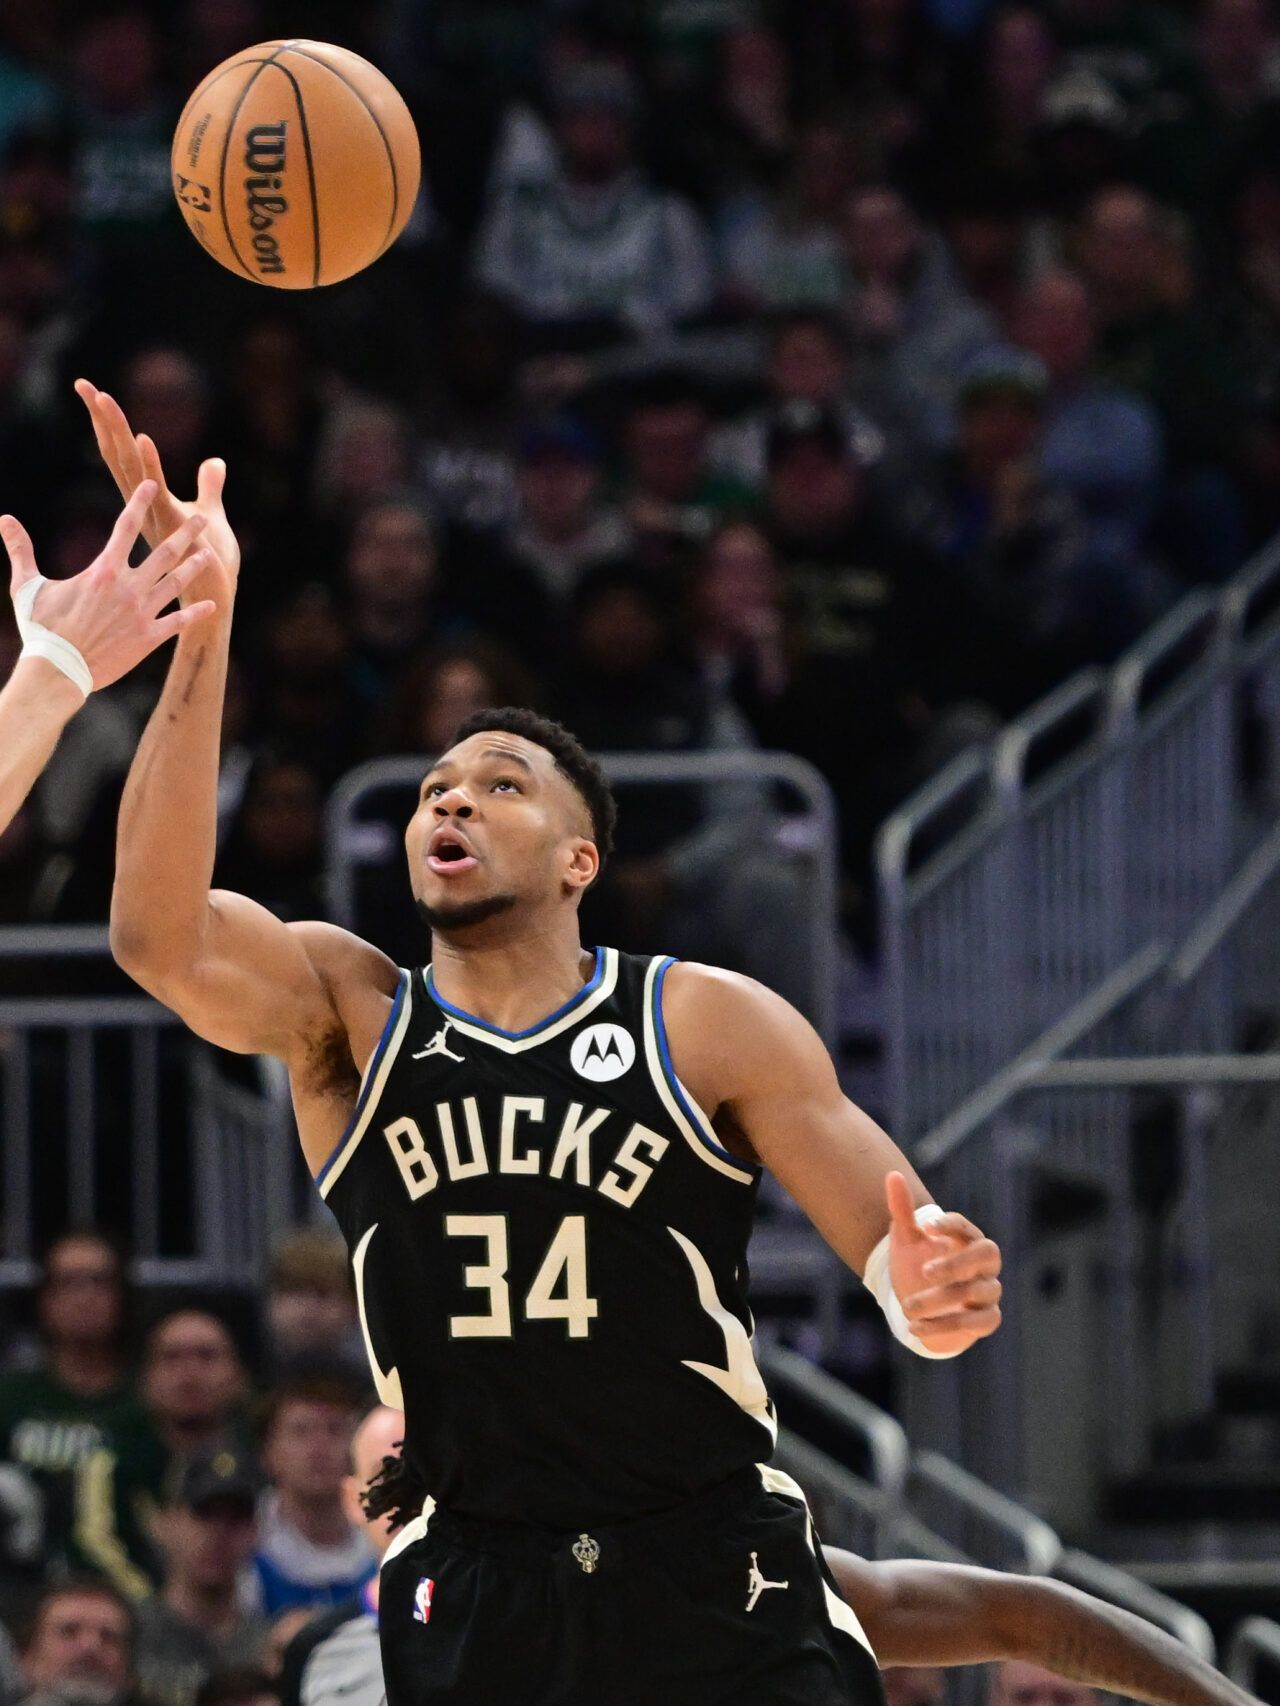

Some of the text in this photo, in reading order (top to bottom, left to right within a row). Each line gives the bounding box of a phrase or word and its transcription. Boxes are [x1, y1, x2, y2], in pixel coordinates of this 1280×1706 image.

[244, 119, 287, 273] Wilson
[384, 1096, 670, 1208] BUCKS
[445, 1214, 598, 1338] 34
